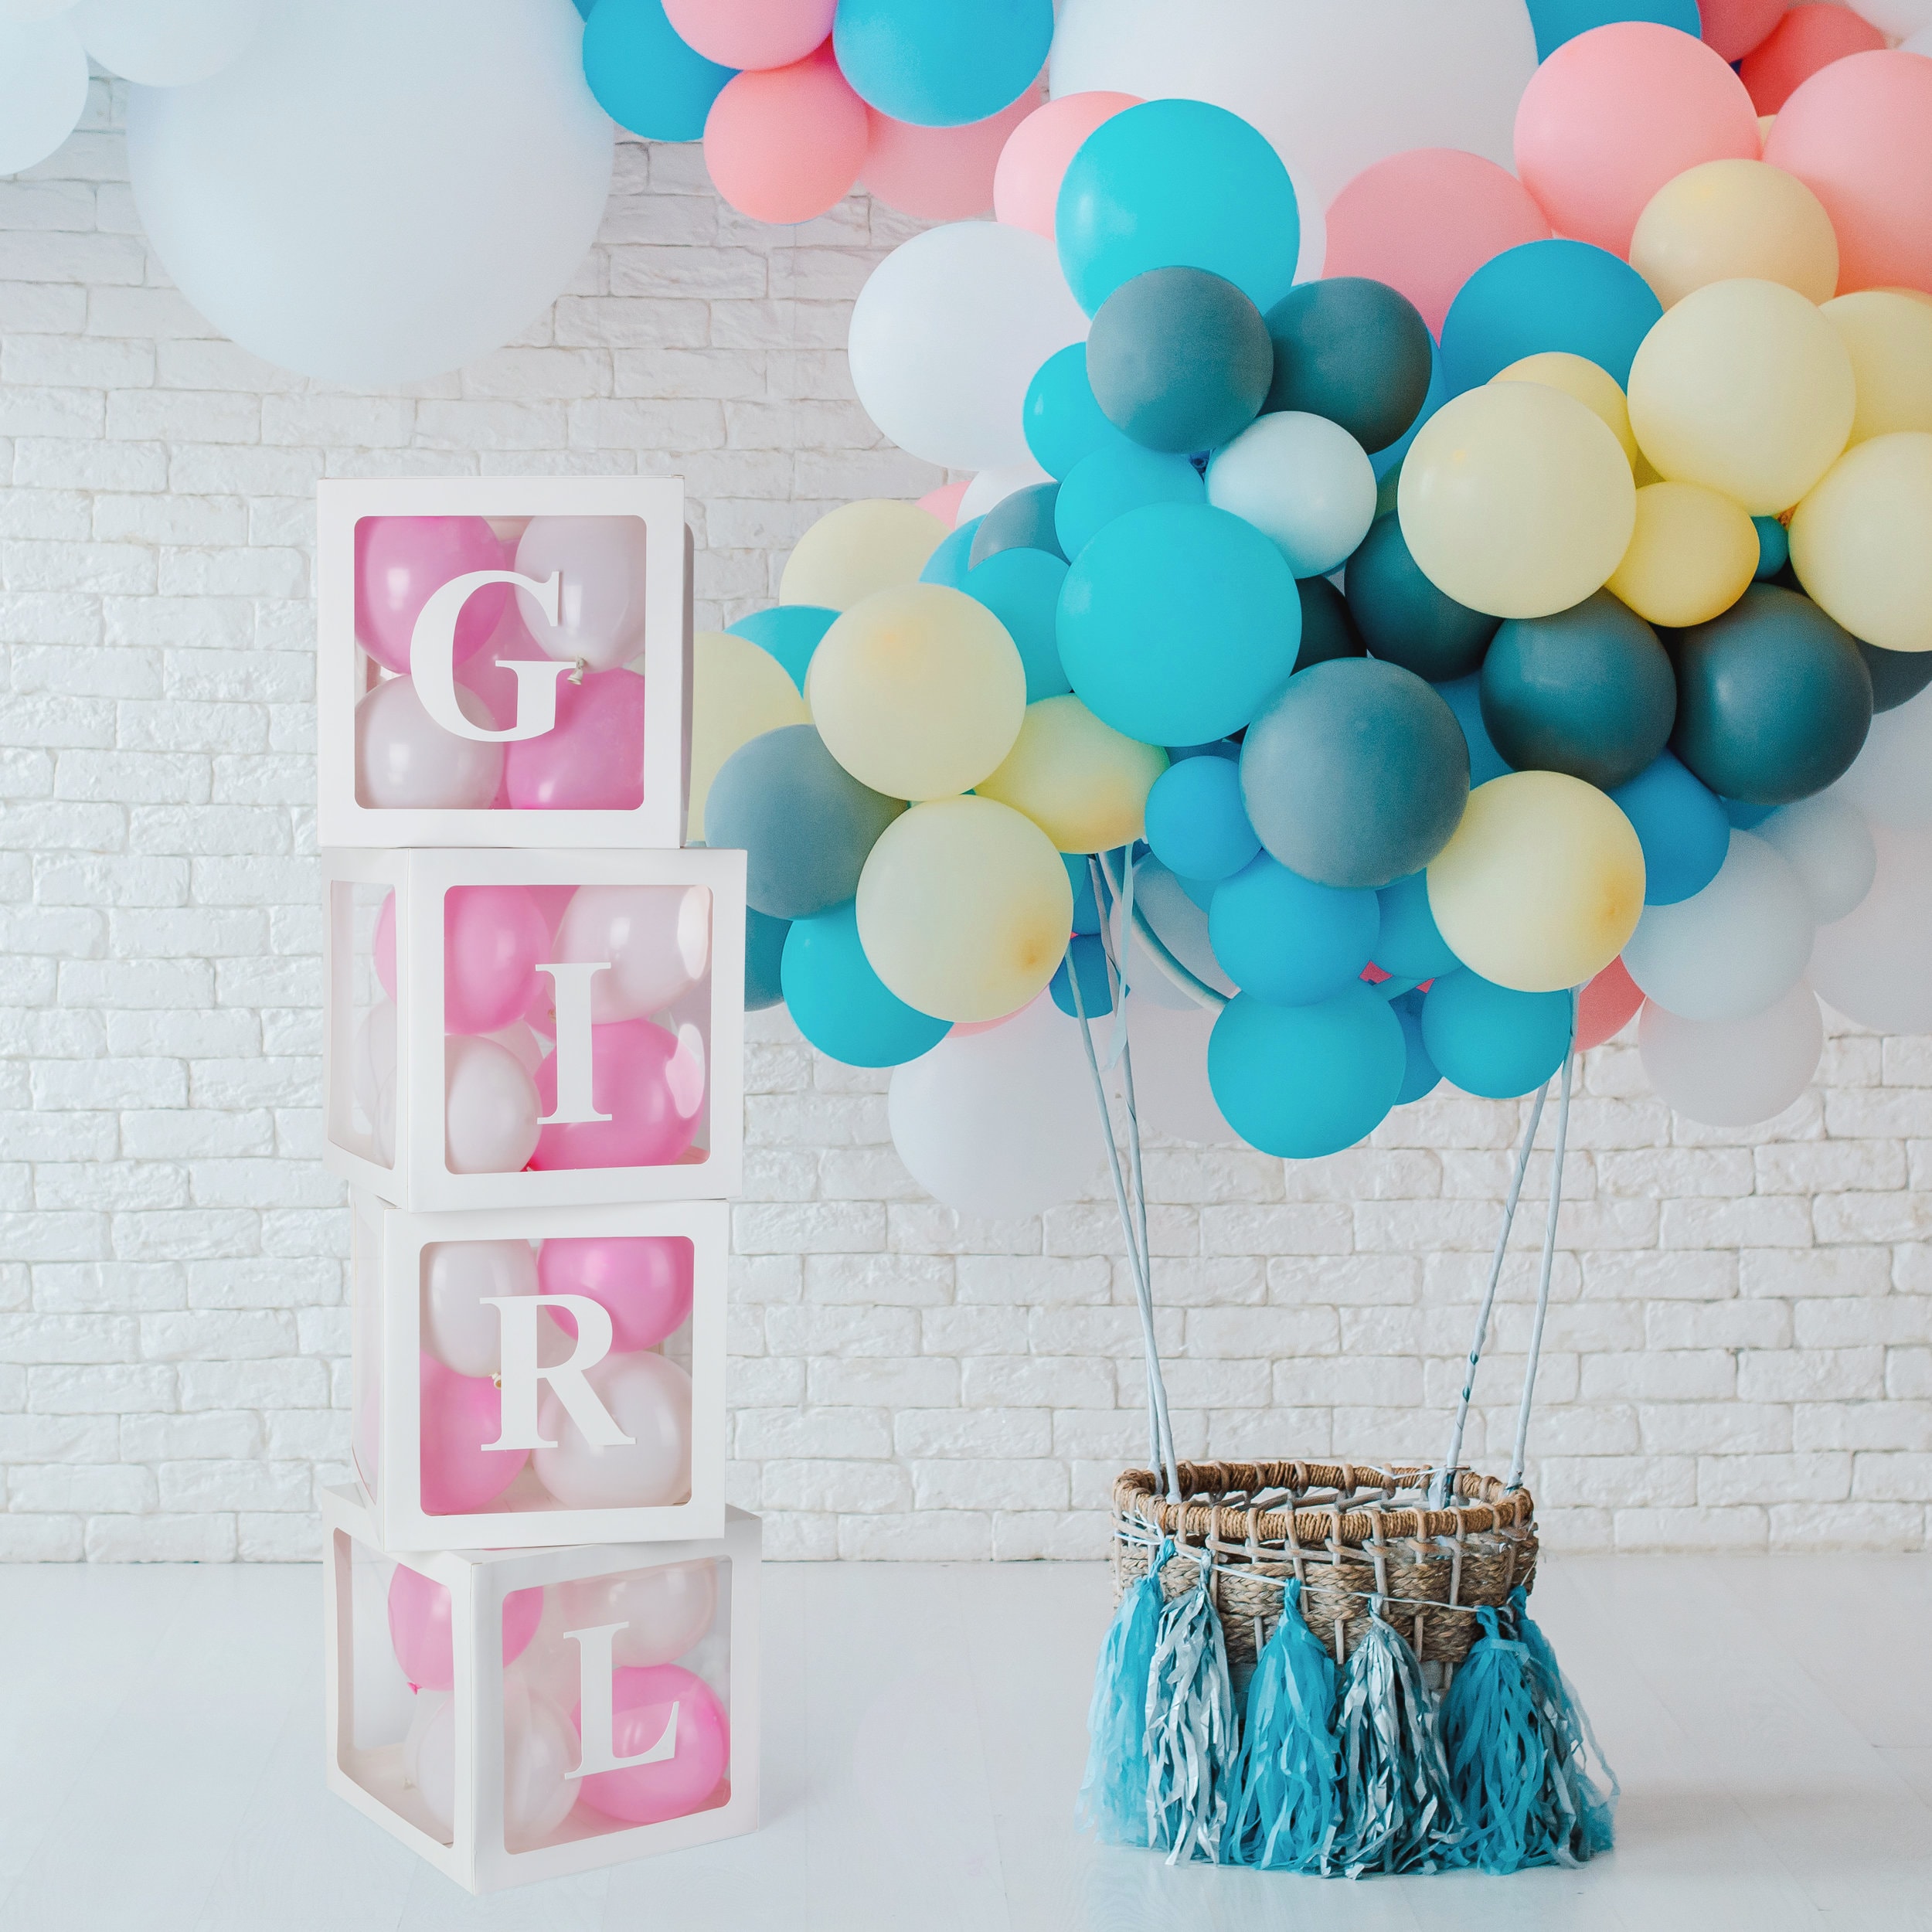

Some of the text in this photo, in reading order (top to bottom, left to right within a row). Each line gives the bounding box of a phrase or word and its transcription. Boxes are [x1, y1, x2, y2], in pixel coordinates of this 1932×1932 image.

[410, 570, 580, 743] G
[535, 961, 613, 1125] I
[478, 1294, 637, 1452] R
[563, 1621, 680, 1781] L
